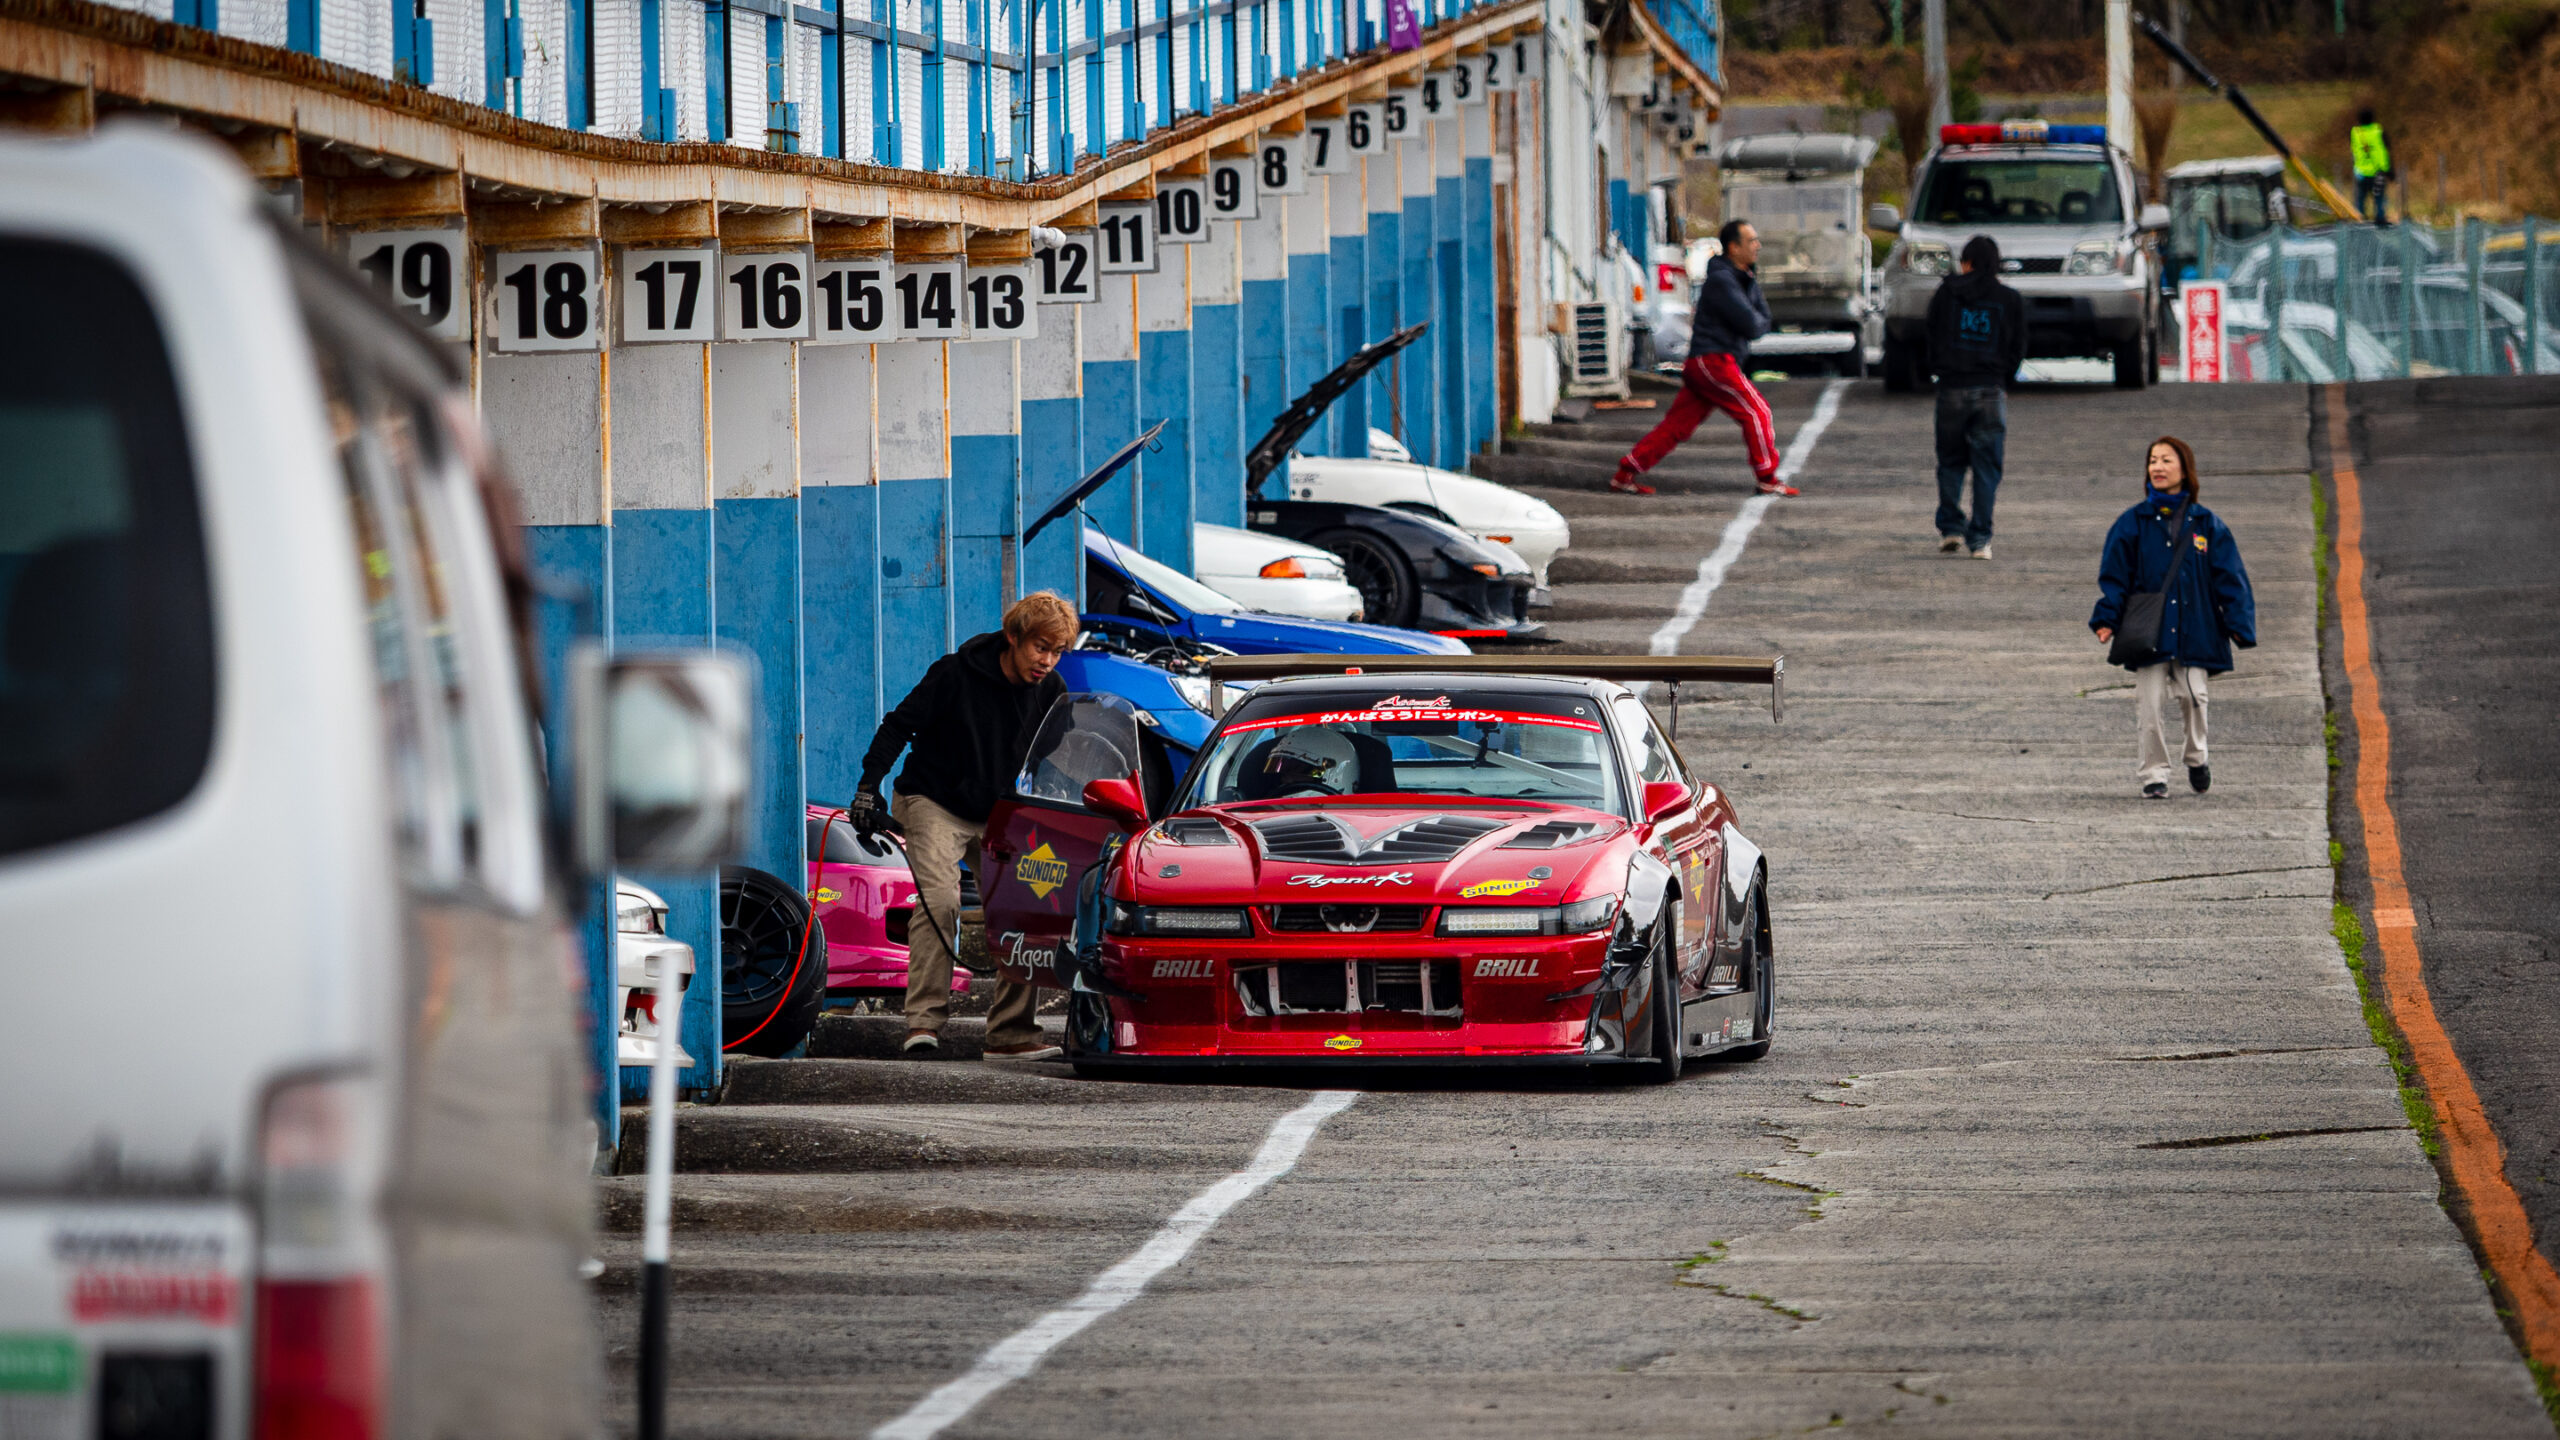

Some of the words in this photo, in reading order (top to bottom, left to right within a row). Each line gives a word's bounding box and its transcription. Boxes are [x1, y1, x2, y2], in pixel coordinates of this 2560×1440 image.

[1486, 51, 1500, 86] 2
[1515, 41, 1526, 75] 1
[1423, 78, 1442, 113] 4
[1454, 63, 1473, 99] 3
[1350, 109, 1371, 149] 6
[1387, 95, 1407, 132] 5
[1263, 145, 1288, 188] 8
[1310, 126, 1331, 168] 7
[1214, 166, 1241, 212] 9
[1157, 187, 1201, 236] 10
[1100, 214, 1145, 264] 11
[358, 240, 452, 328] 19
[1035, 242, 1089, 295] 12
[504, 261, 588, 340] 18
[634, 260, 702, 331] 17
[729, 261, 802, 331] 16
[816, 270, 885, 332] 15
[893, 271, 957, 330] 14
[967, 274, 1025, 330] 13
[1018, 857, 1067, 885] SUNOCO
[1465, 880, 1537, 897] SUNOCO
[808, 889, 842, 899] SNOCO
[1000, 931, 1054, 981] Agen
[1152, 960, 1215, 978] BRILL
[1473, 959, 1541, 977] BRILL
[1711, 965, 1738, 983] BRILL
[1326, 1038, 1362, 1048] SUNOCO
